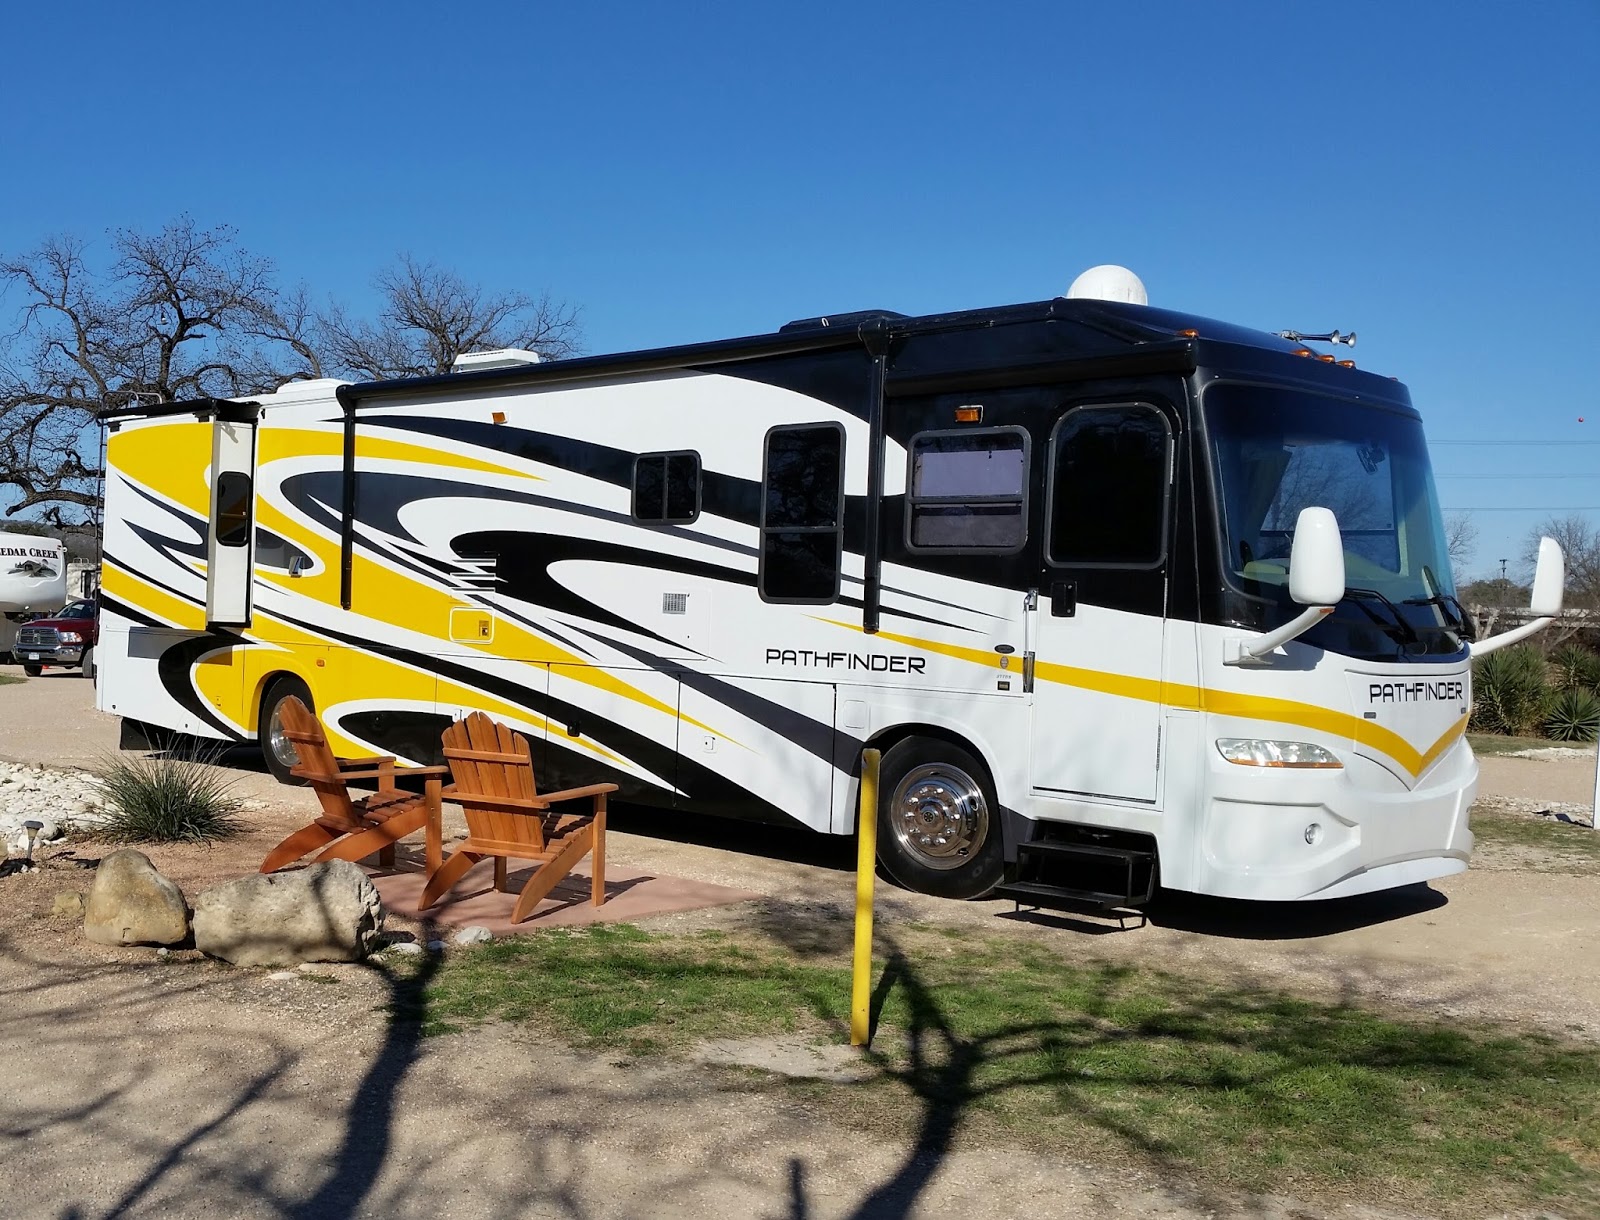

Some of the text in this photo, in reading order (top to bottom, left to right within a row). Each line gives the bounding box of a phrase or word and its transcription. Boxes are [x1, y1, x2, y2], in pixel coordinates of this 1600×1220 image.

[0, 547, 59, 559] EDAR CREEK
[766, 648, 926, 675] PATHFINDER
[1369, 682, 1463, 703] PATHFINDER
